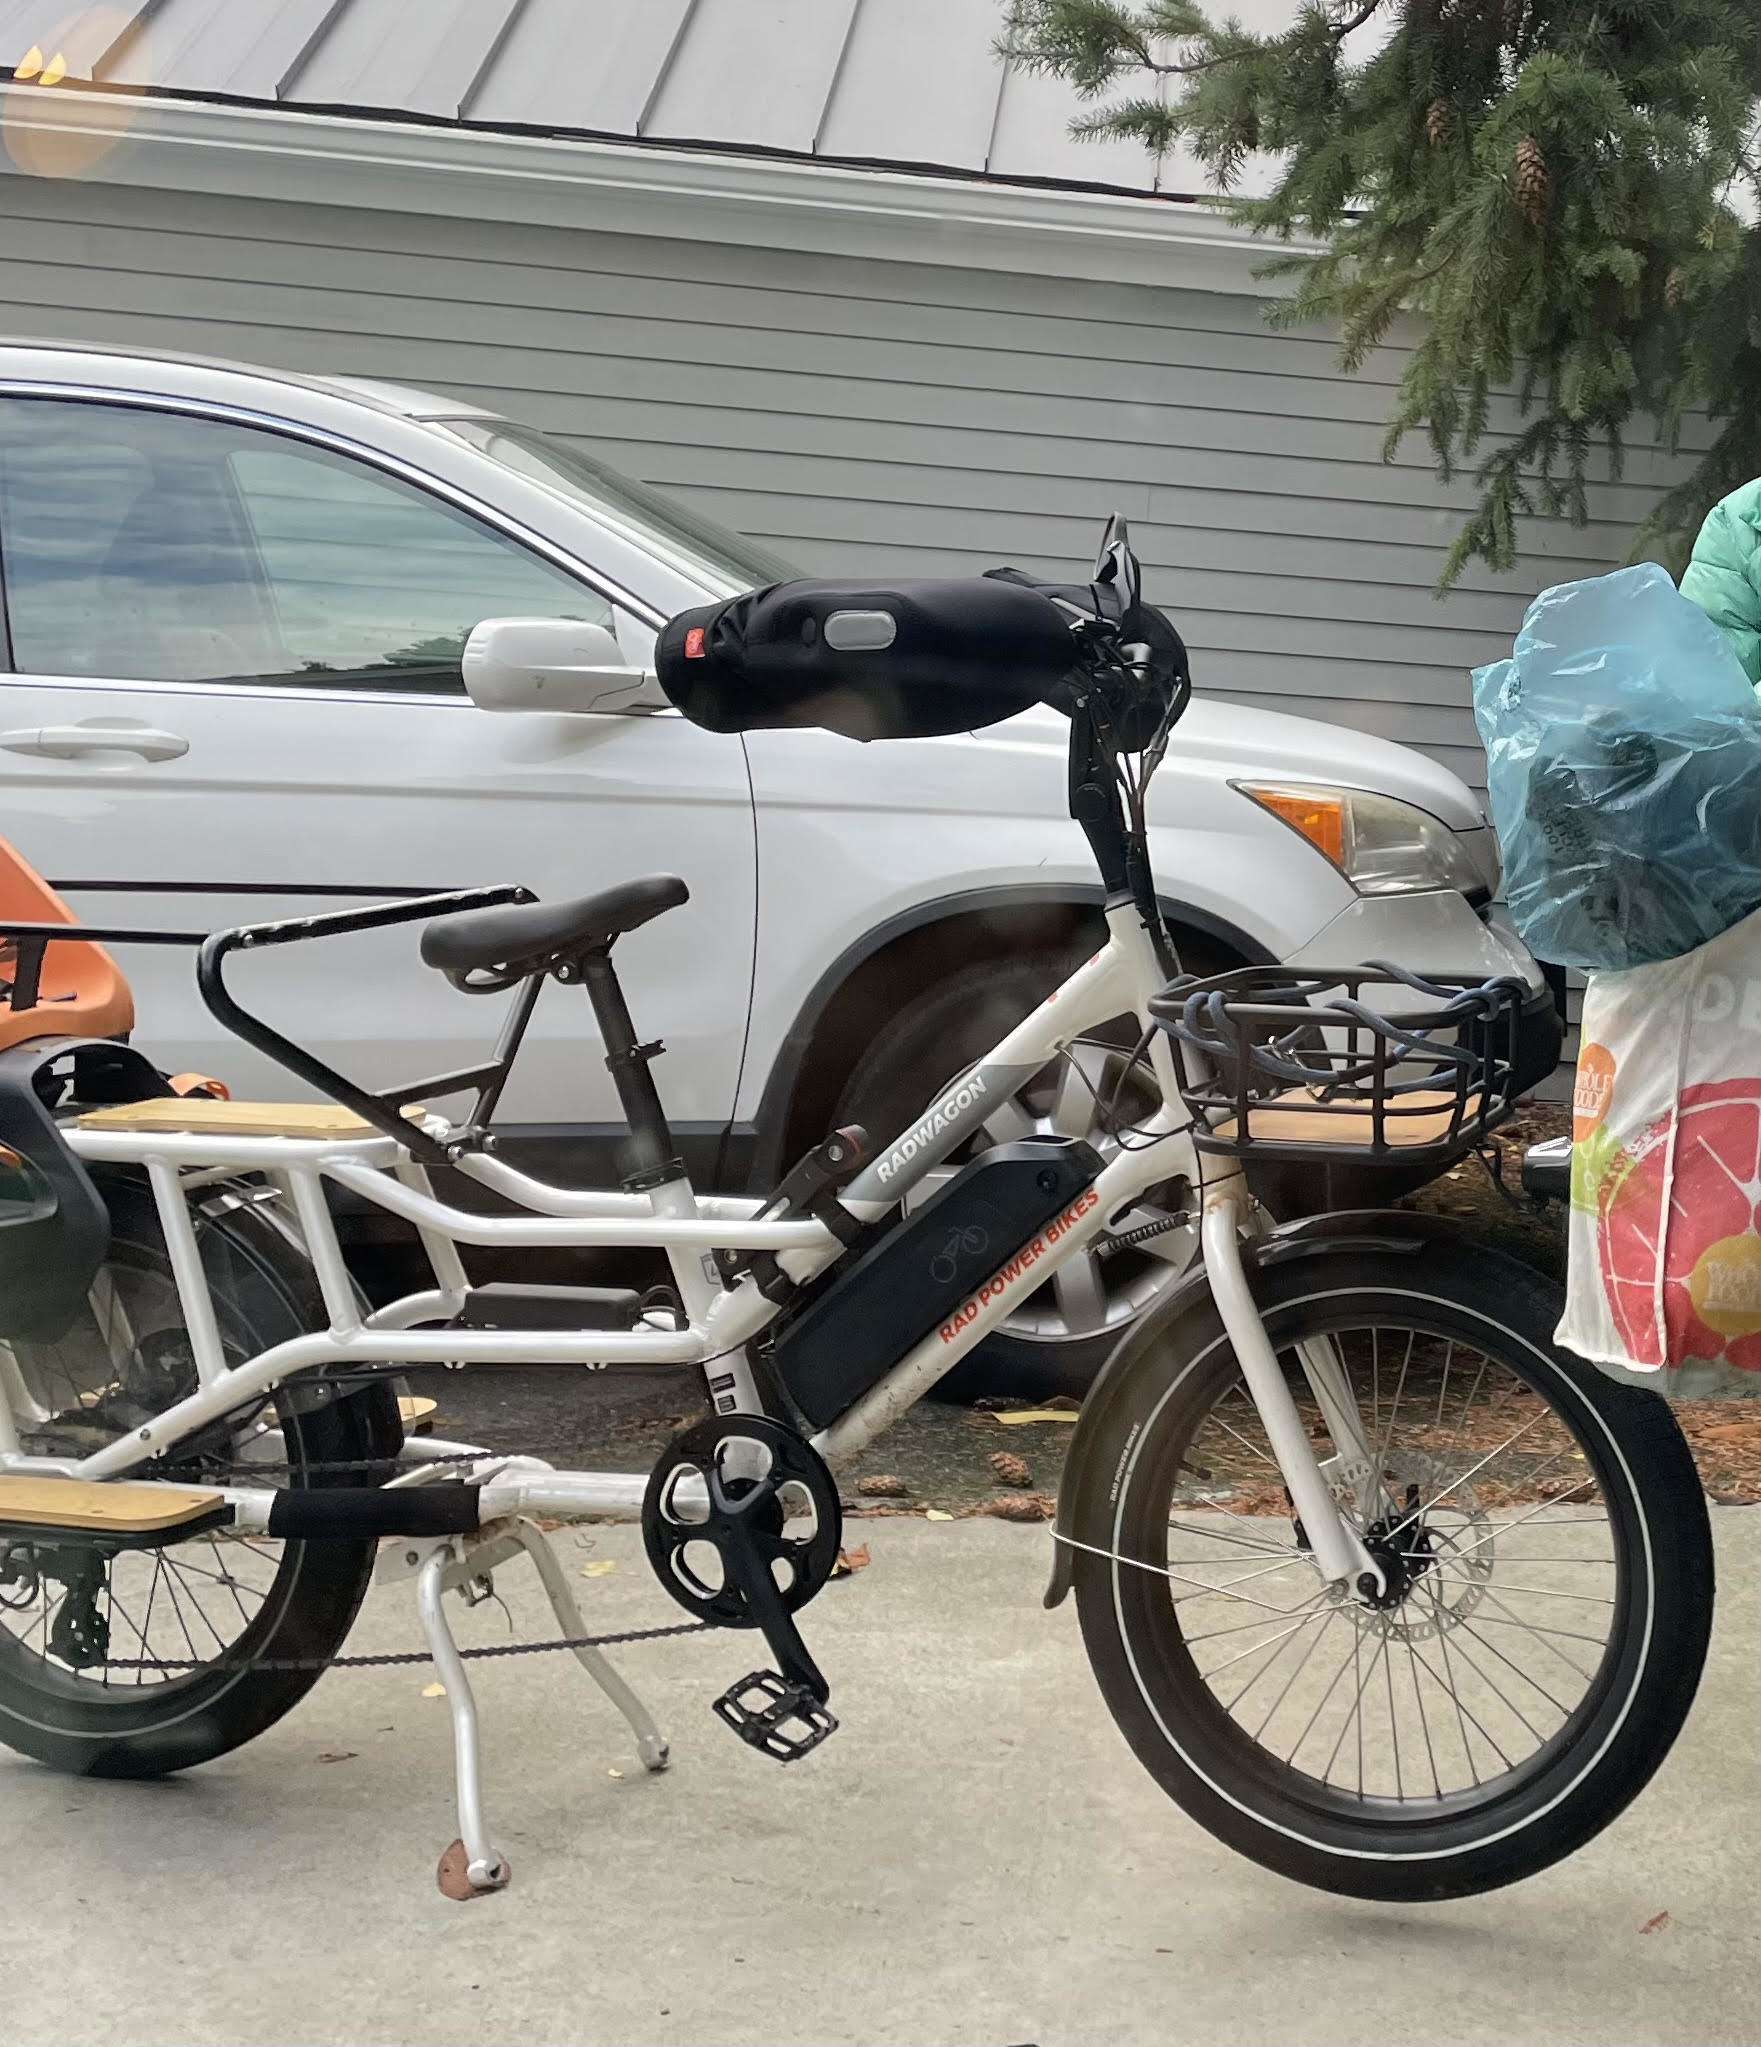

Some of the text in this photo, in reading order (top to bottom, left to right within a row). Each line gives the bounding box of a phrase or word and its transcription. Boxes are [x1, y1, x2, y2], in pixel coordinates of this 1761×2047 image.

[876, 1075, 987, 1184] RADWAGON
[939, 1186, 1099, 1344] RAD POWER BIKES
